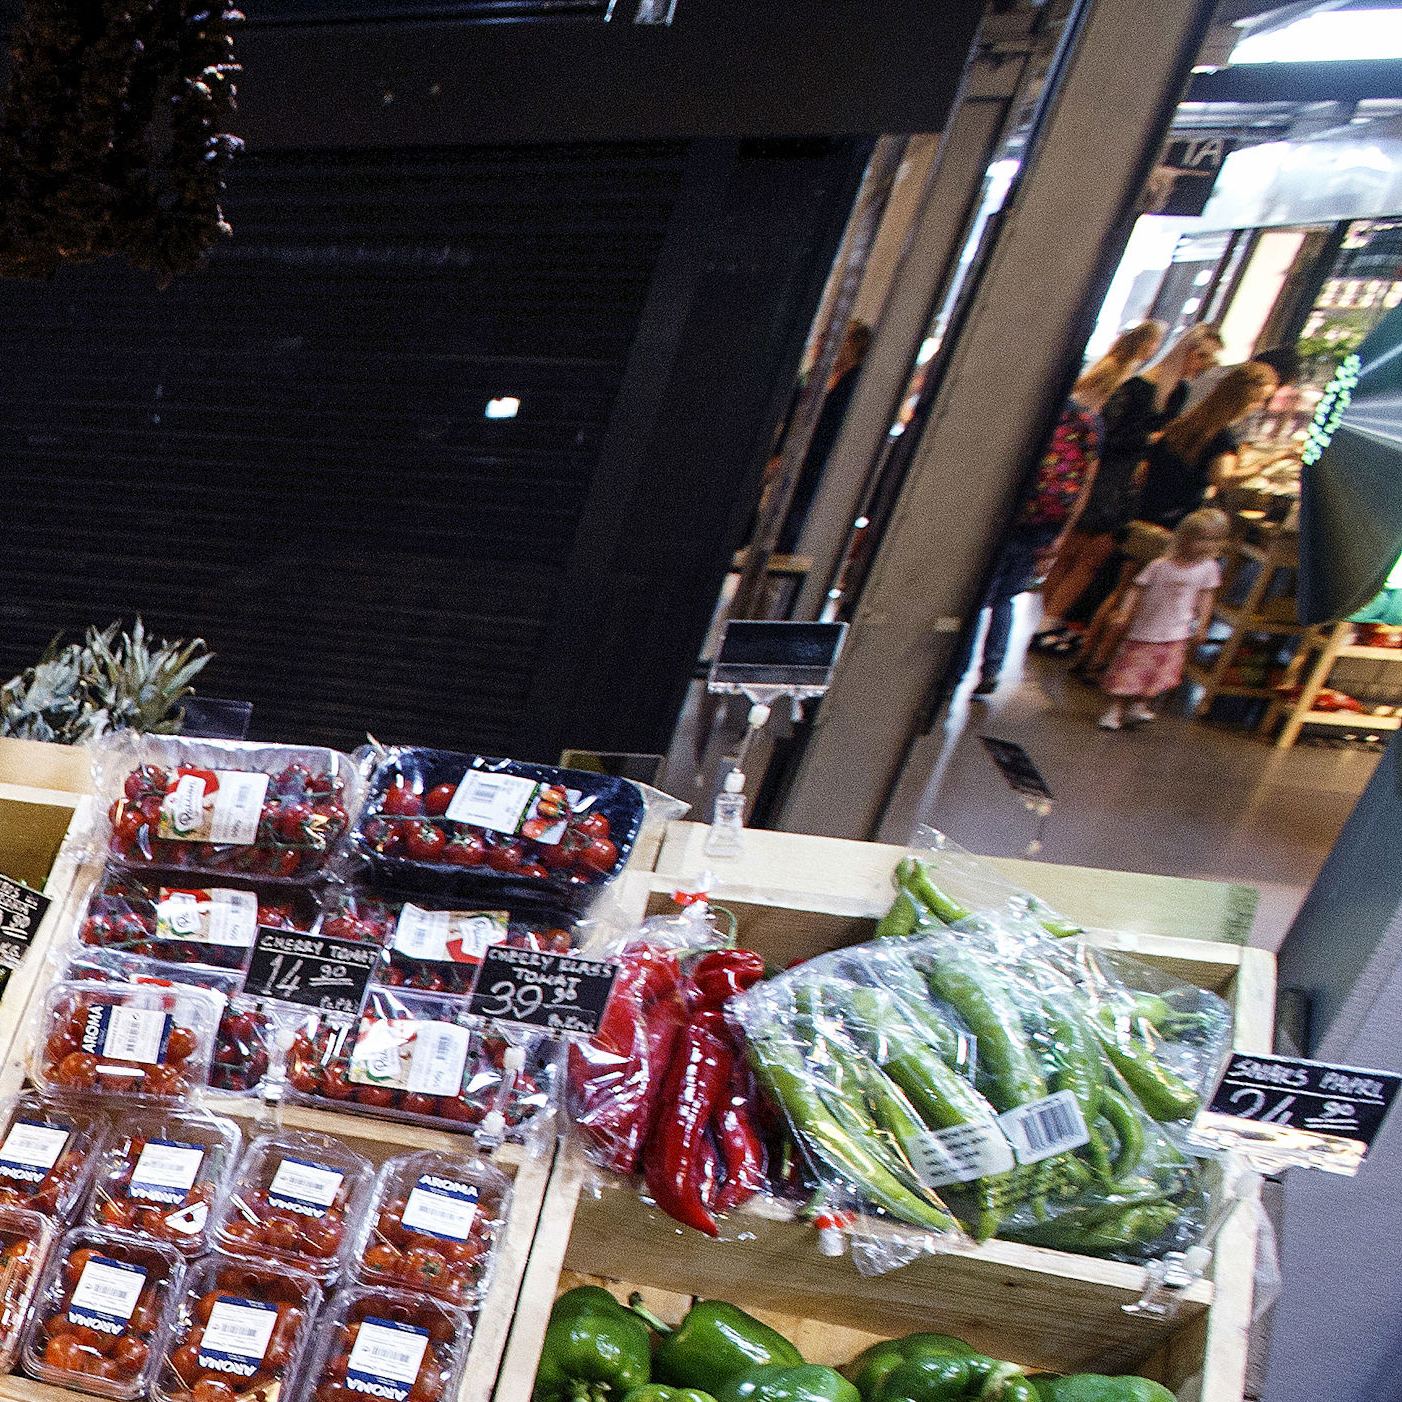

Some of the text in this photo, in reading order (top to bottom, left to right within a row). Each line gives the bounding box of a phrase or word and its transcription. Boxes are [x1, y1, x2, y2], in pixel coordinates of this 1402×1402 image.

[260, 935, 324, 955] CHERRY
[489, 949, 554, 971] CHERRY
[261, 953, 303, 998] 14
[482, 980, 543, 1019] 39
[81, 1003, 105, 1054] AROMA
[419, 1174, 479, 1198] AROMA
[267, 1196, 327, 1219] AROMA
[69, 1311, 125, 1336] AROMA
[198, 1355, 258, 1377] AROMA
[345, 1376, 409, 1402] AROMA
